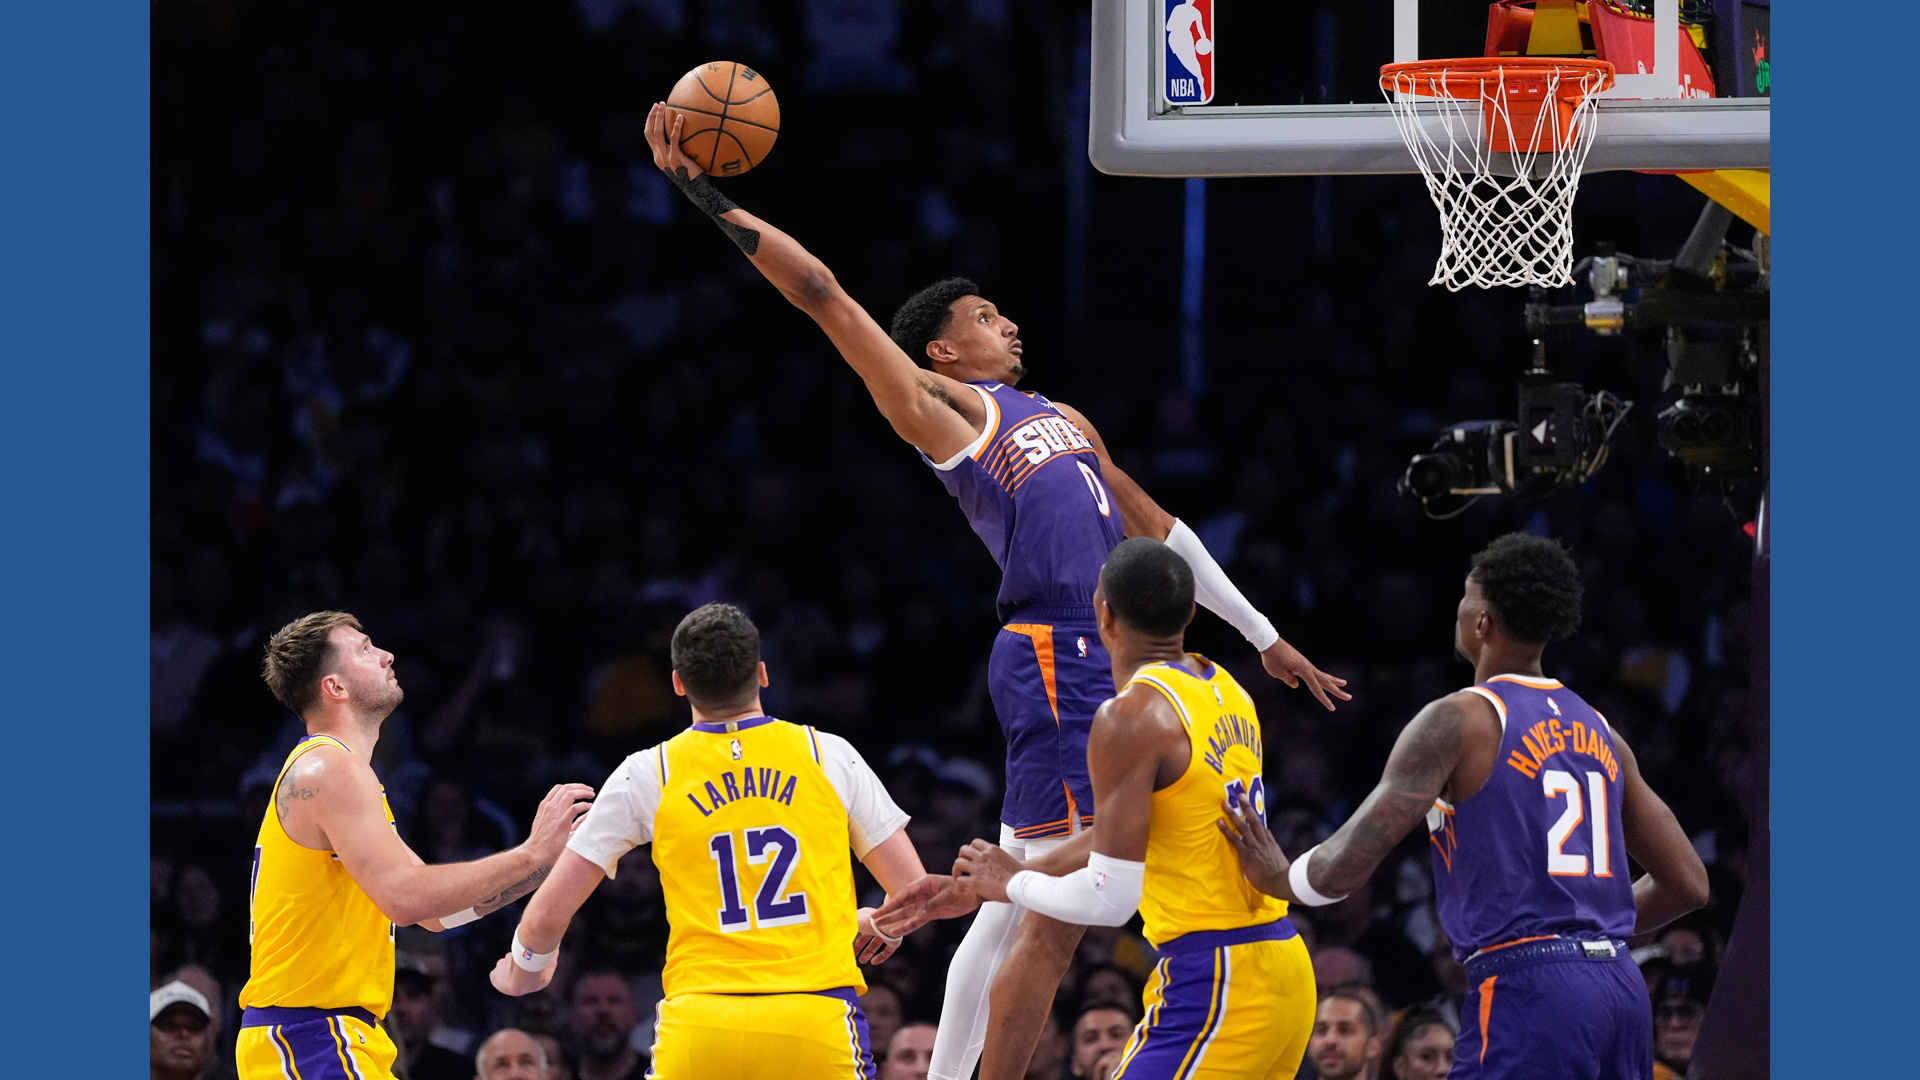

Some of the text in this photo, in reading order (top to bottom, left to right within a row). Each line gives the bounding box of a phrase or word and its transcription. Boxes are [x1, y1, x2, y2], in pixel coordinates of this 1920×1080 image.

[1171, 78, 1195, 97] NBA
[1076, 460, 1110, 517] 0
[1204, 714, 1261, 775] HACHIMURA
[1507, 718, 1618, 783] HAYES-DAVIS
[687, 766, 797, 818] LARAVIA
[1542, 769, 1614, 878] 21
[708, 824, 810, 933] 12
